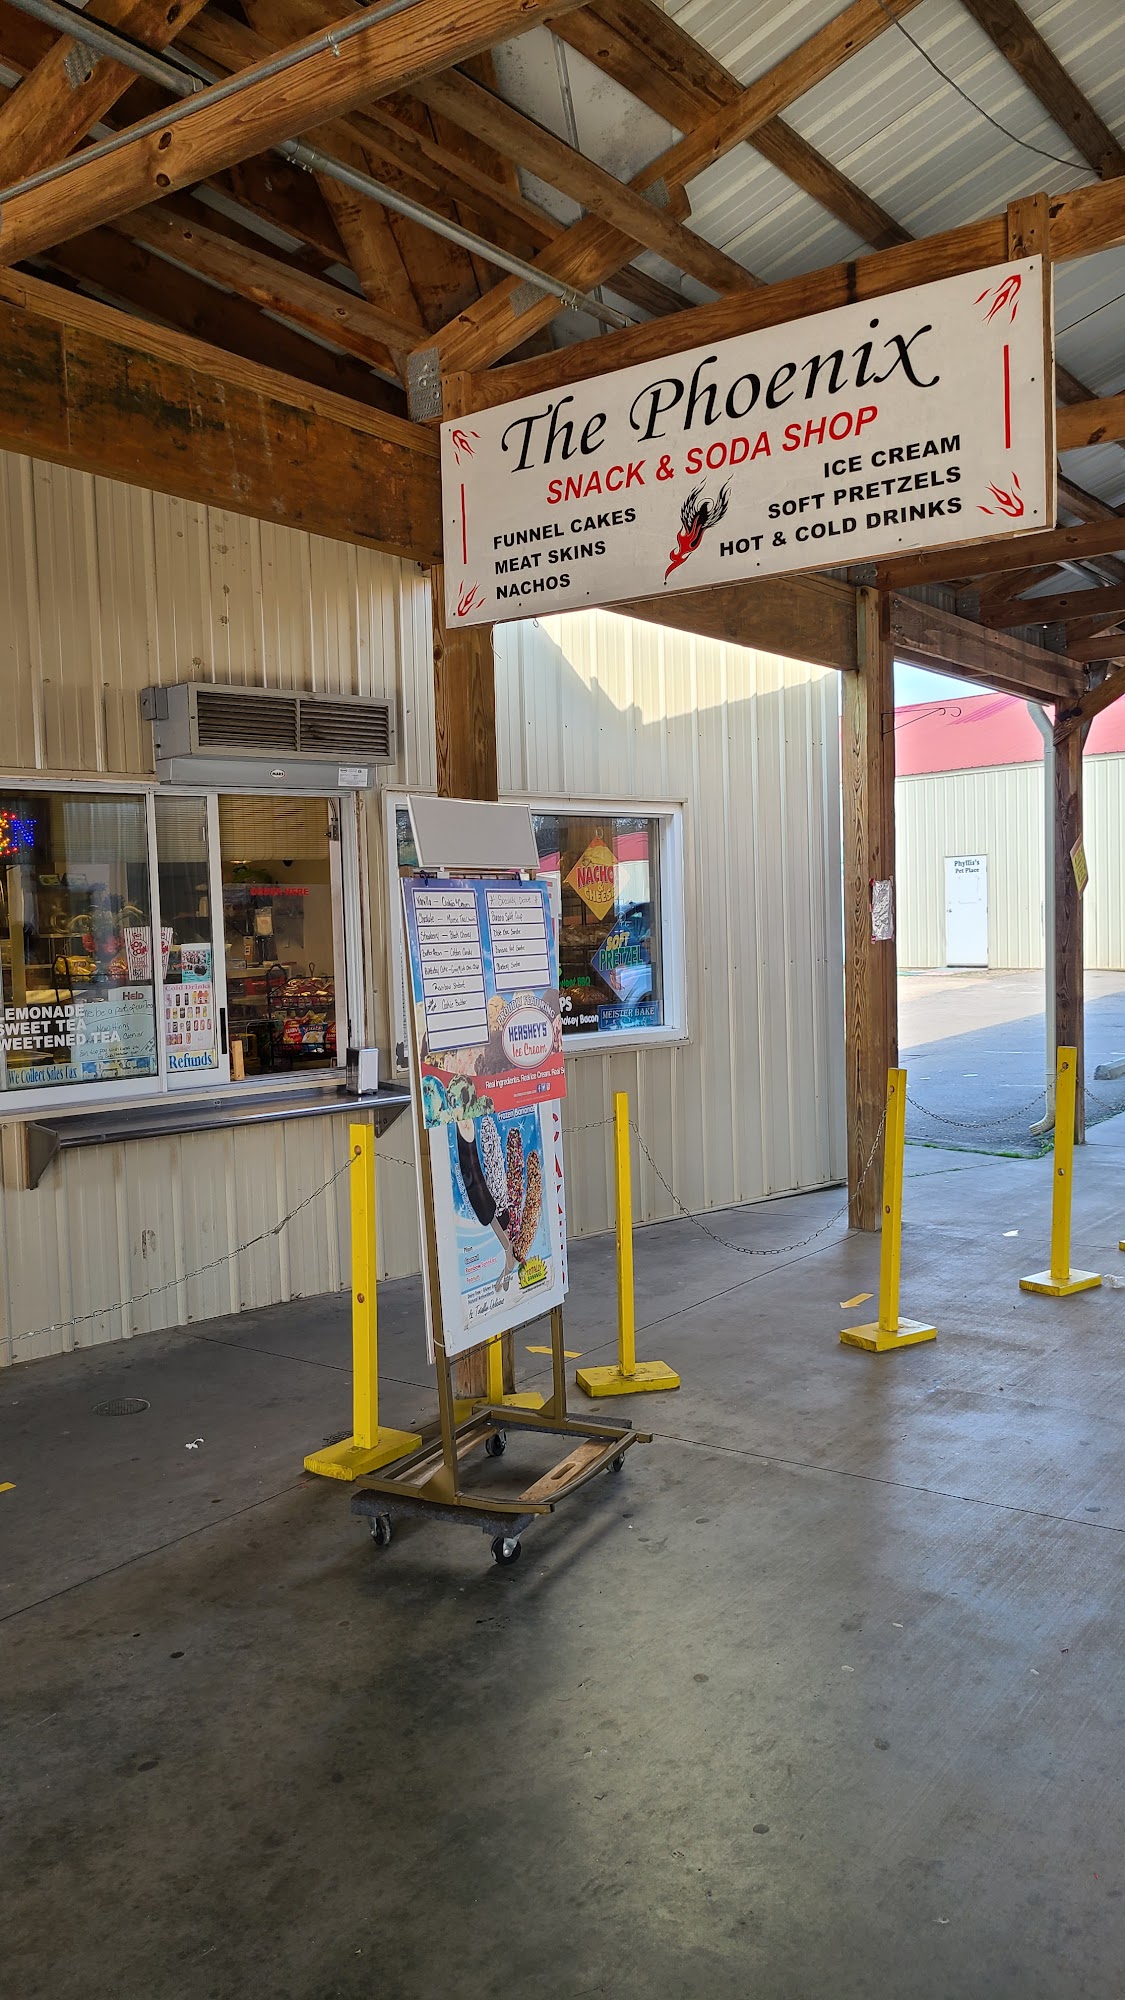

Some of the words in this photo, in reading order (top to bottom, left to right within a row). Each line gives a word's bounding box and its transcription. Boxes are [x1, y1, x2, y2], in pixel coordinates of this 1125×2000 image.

[502, 396, 606, 472] The
[630, 319, 939, 442] Phoenix
[547, 461, 644, 504] SNACK
[656, 455, 674, 480] &
[685, 432, 771, 474] SODA
[782, 406, 878, 451] SHOP
[824, 456, 863, 479] ICE
[872, 435, 960, 467] CREAM
[768, 493, 824, 519] SOFT
[834, 467, 960, 505] PRETZELS
[494, 524, 565, 549] FUNNEL
[571, 508, 636, 532] CAKES
[720, 535, 764, 557] HOT
[773, 532, 787, 547] &
[796, 518, 856, 541] COLD
[867, 497, 961, 530] DRINKS
[495, 553, 541, 575] MEAT
[548, 541, 606, 563] SKINS
[497, 574, 570, 600] NACHOS
[954, 859, 980, 867] Phyllis's
[576, 865, 618, 890] NACHO
[285, 888, 309, 896] HERE
[606, 931, 630, 951] SOFT
[600, 945, 643, 971] PRETZEL
[0, 1003, 85, 1021] EMONADE
[96, 1006, 106, 1016] be
[497, 995, 522, 1025] PROUDLY
[523, 994, 556, 1019] FEATURING
[580, 1014, 599, 1024] Bacon
[602, 1009, 634, 1019] MEISTER
[635, 1007, 655, 1016] BAKE
[0, 1020, 51, 1036] SWEET
[56, 1019, 87, 1032] TEA
[91, 1031, 121, 1044] TEA
[508, 1021, 547, 1042] HERSHEY'S
[512, 1043, 523, 1057] Ice
[523, 1042, 546, 1056] Cream
[169, 1052, 212, 1069] Refunds
[21, 1067, 45, 1083] Collect
[485, 1080, 496, 1089] Real
[521, 1074, 530, 1082] Real
[551, 1068, 560, 1076] Real
[498, 1109, 514, 1121] Frozen
[514, 1104, 536, 1116] Bananas
